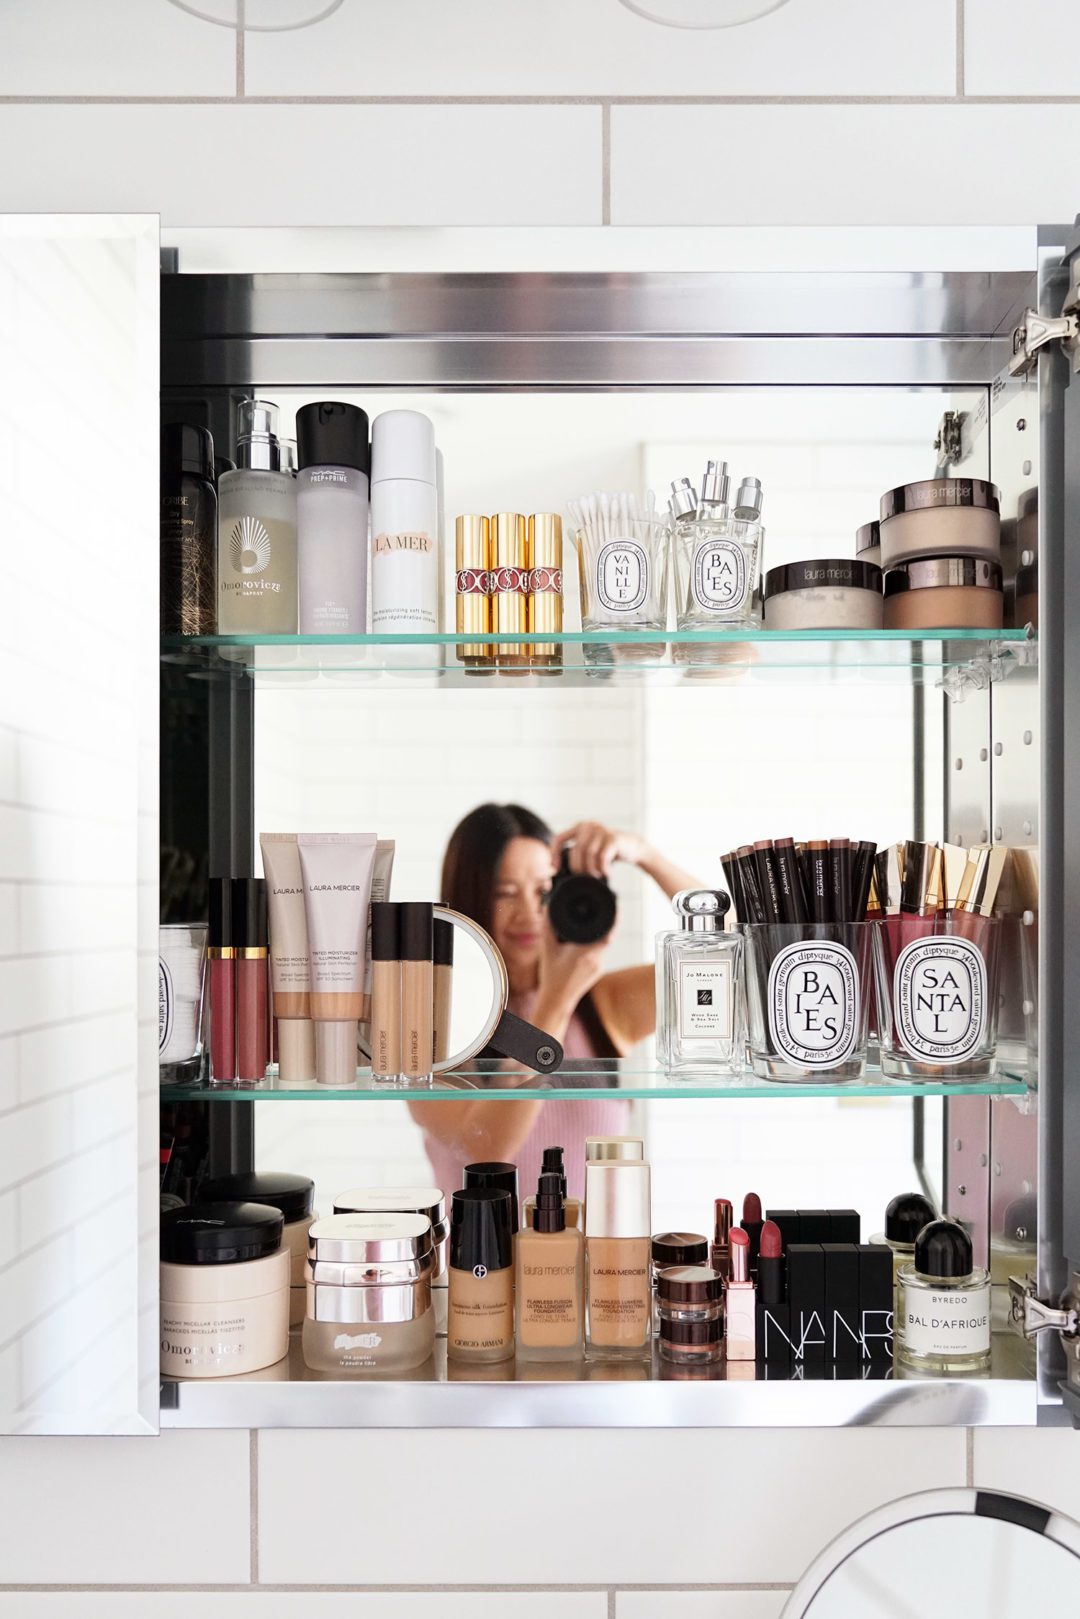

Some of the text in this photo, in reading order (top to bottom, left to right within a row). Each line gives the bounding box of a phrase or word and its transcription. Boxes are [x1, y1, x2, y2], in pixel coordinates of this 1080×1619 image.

[376, 535, 428, 552] LA MER
[804, 568, 825, 580] laura
[333, 884, 360, 892] MERCIER
[798, 952, 834, 961] diptyque
[923, 947, 959, 956] diptyque
[523, 1264, 543, 1276] laura
[932, 1296, 968, 1304] BYREDO
[908, 1314, 928, 1327] BAL
[481, 1338, 504, 1348] ARMANI
